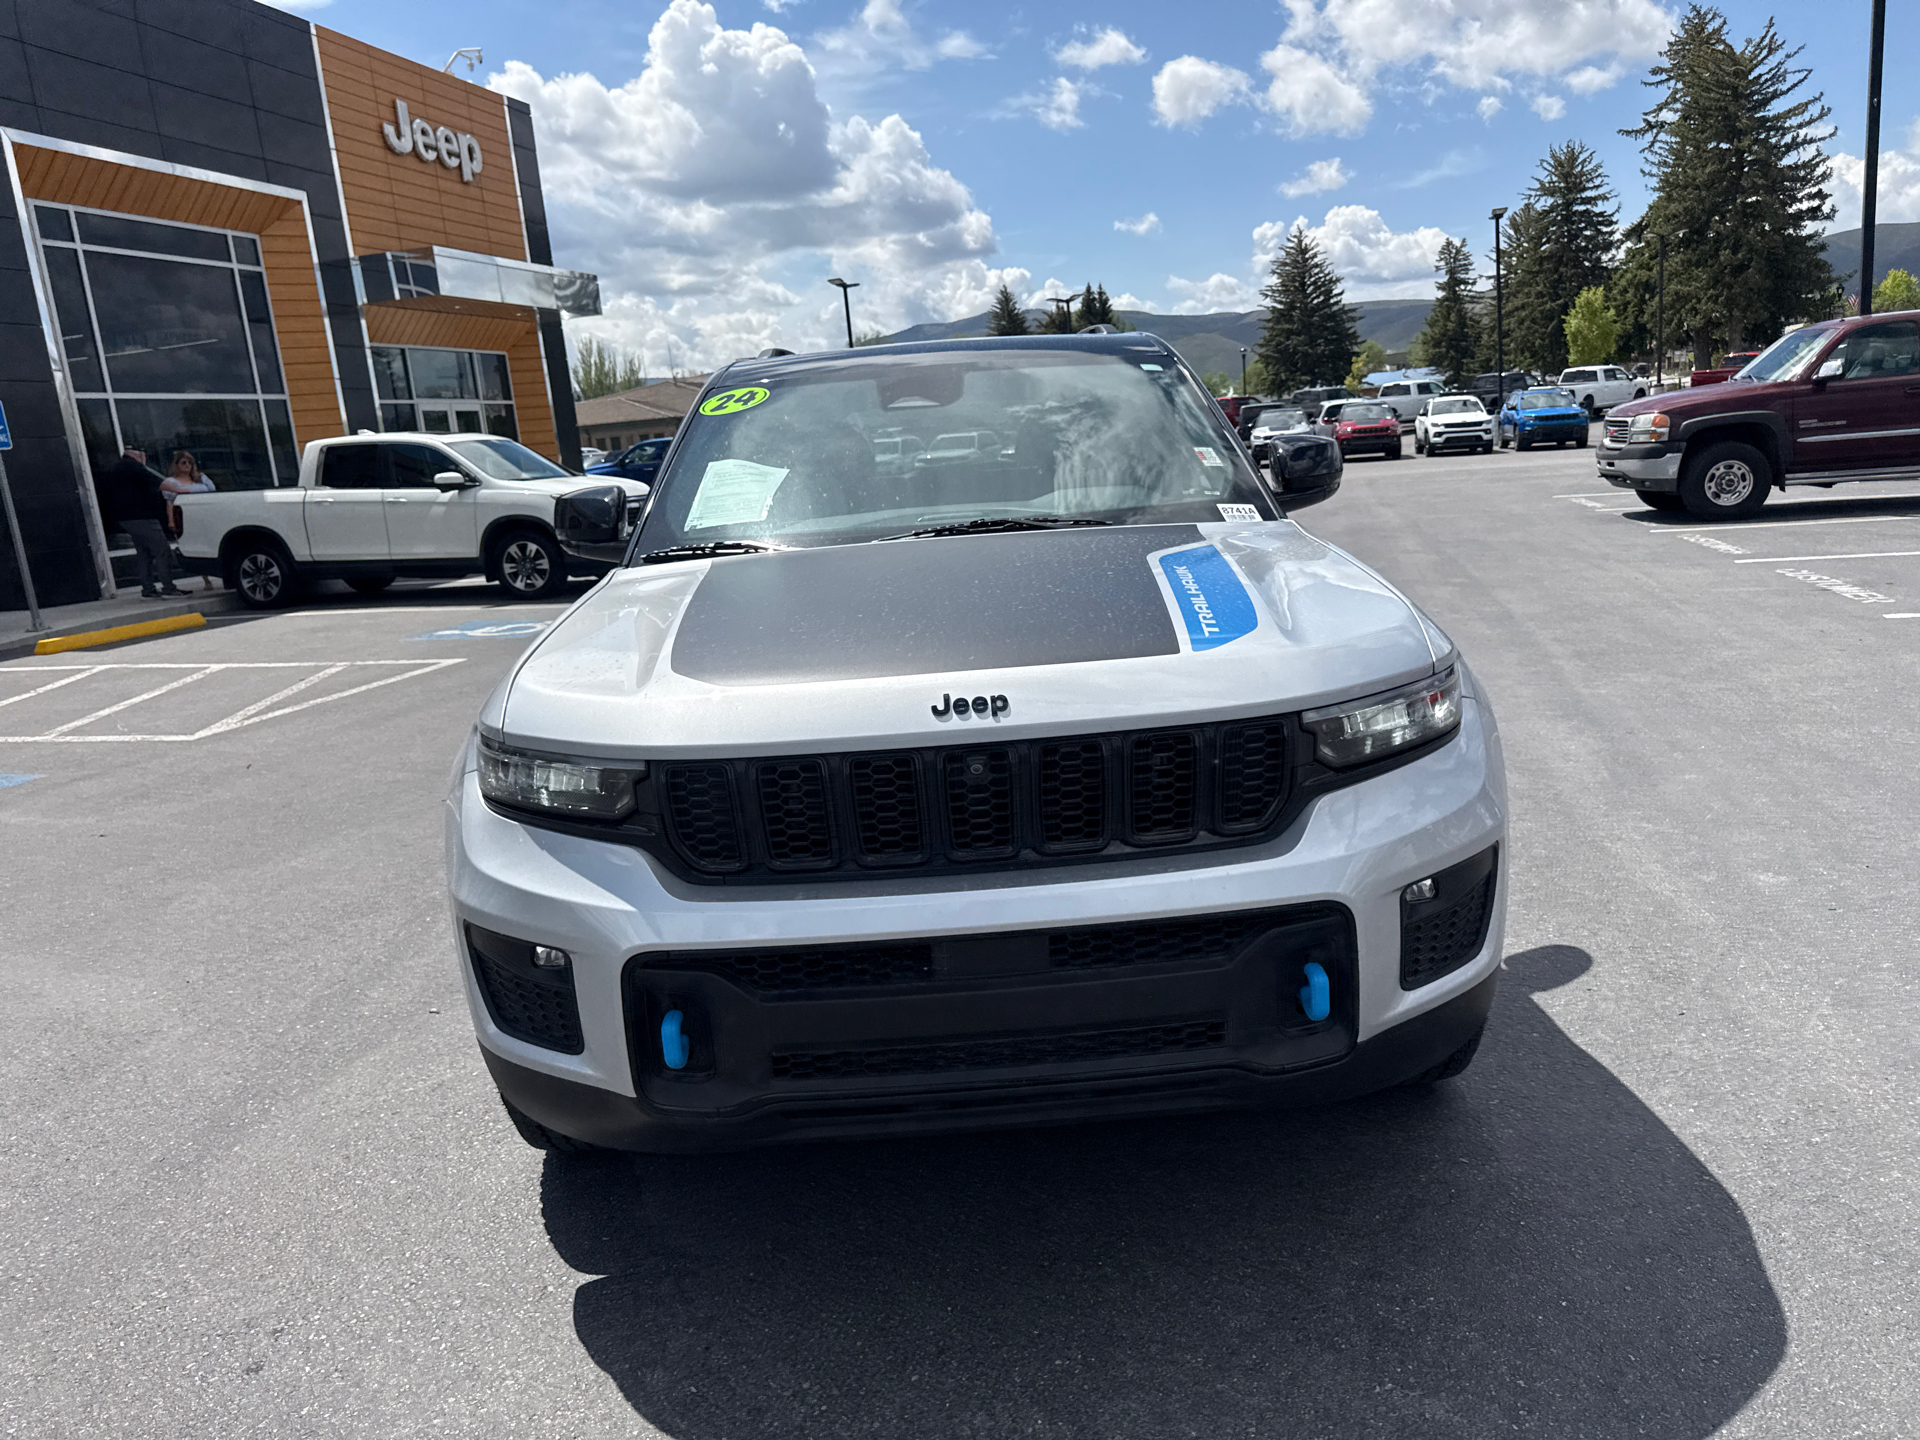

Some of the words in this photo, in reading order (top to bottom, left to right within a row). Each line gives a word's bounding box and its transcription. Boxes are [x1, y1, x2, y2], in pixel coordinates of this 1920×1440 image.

[383, 98, 483, 182] Jeep
[709, 390, 759, 412] 24
[1221, 506, 1256, 515] 8741A
[1173, 565, 1220, 638] TRAILHAWK
[931, 693, 1009, 717] Jeep
